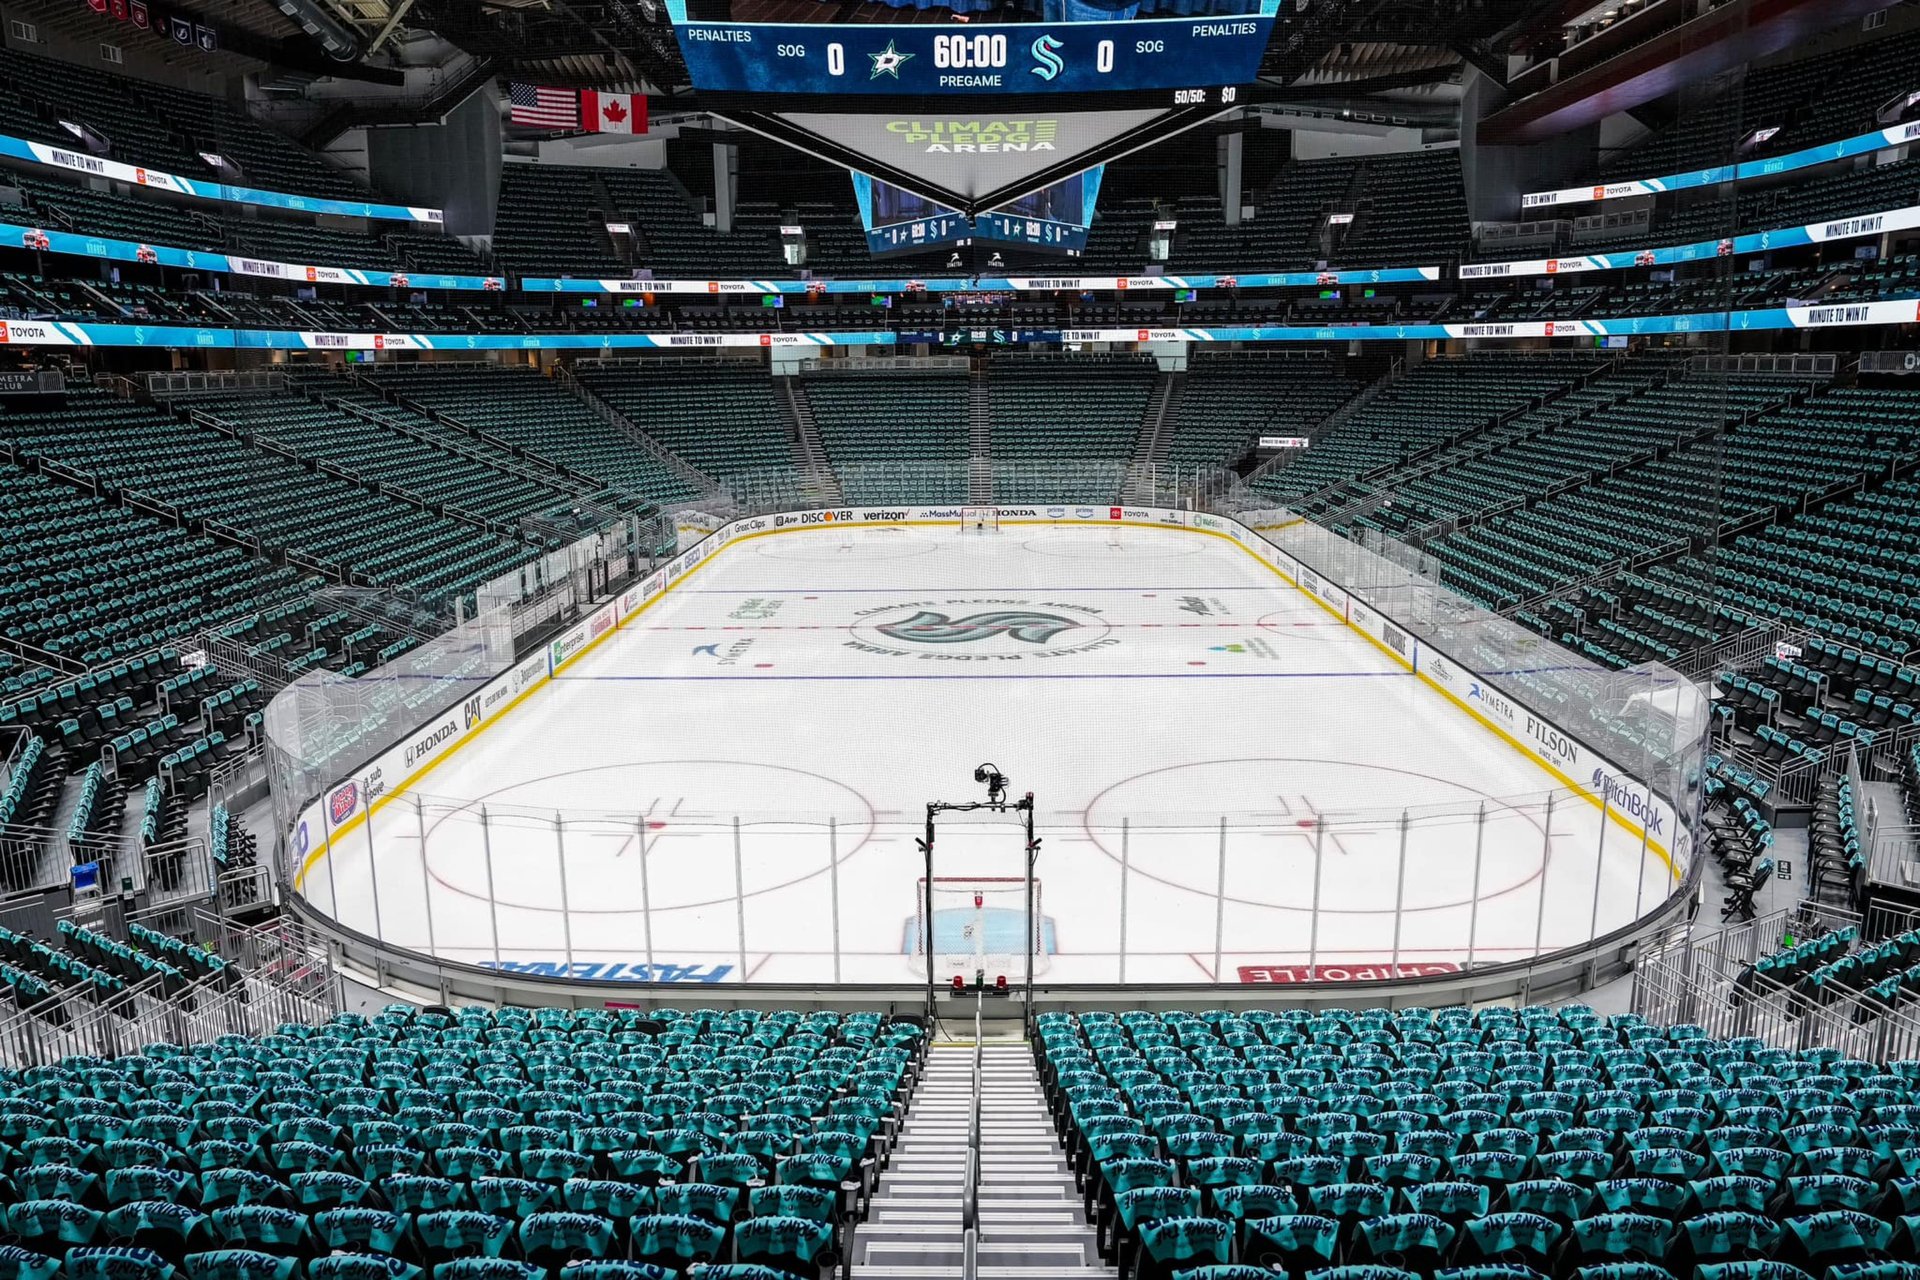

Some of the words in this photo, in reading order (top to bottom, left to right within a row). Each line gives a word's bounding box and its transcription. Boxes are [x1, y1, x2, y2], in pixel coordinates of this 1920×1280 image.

[688, 30, 752, 42] PENALTIES
[1192, 23, 1257, 37] PENALTIES
[777, 44, 806, 57] SOG
[934, 34, 1007, 69] 60:00
[1136, 40, 1165, 53] SOG
[827, 43, 845, 76] 0
[1097, 40, 1114, 73] 0
[939, 75, 1002, 87] PREGAME
[1174, 89, 1206, 104] 50/50:
[1222, 86, 1236, 103] $0
[925, 142, 1056, 153] ARENA
[52, 150, 75, 167] MINUTE
[77, 156, 84, 168] TO
[86, 158, 97, 170] WIN
[98, 161, 104, 172] IT
[148, 174, 168, 185] TOYOTA
[1606, 186, 1632, 194] TOYOTA
[1531, 196, 1538, 205] TO
[1540, 194, 1550, 204] WIN
[1552, 193, 1557, 202] IT
[1826, 223, 1850, 237] MINUTE
[1851, 220, 1859, 234] TO
[1861, 218, 1875, 232] WIN
[1876, 216, 1883, 229] IT
[1462, 266, 1483, 276] MINUTE
[1484, 266, 1491, 275] TO
[1492, 264, 1503, 274] WIN
[1504, 264, 1510, 274] IT
[620, 282, 642, 291] MINUTE
[644, 282, 652, 291] TO
[653, 282, 666, 291] WIN
[666, 282, 672, 291] IT
[1028, 280, 1051, 288] MINUTE
[1053, 280, 1060, 288] TO
[1062, 280, 1074, 288] WIN
[1074, 279, 1080, 288] IT
[1808, 308, 1834, 323] MINUTE
[1836, 308, 1844, 322] TO
[1846, 307, 1860, 322] WIN
[1861, 306, 1870, 320] IT
[10, 326, 46, 338] TOYOTA
[1072, 332, 1080, 340] TO
[1081, 332, 1093, 340] WIN
[1094, 331, 1100, 340] IT
[1463, 326, 1484, 336] MINUTE
[1486, 325, 1494, 335] TO
[1495, 325, 1507, 334] WIN
[1508, 325, 1514, 334] IT
[385, 338, 406, 346] TOYOTA
[671, 336, 694, 346] MINUTE
[695, 336, 702, 345] TO
[704, 336, 716, 345] WIN
[716, 336, 722, 345] IT
[802, 510, 853, 524] DISCOVER
[863, 509, 905, 522] verizon
[735, 522, 749, 533] Great
[750, 520, 766, 531] Clips
[1481, 688, 1514, 721] SYMETRA
[464, 695, 482, 730] CAT
[415, 720, 458, 758] HONDA
[1526, 716, 1578, 765] FILSON
[370, 766, 382, 783] sub
[366, 781, 384, 799] bove
[1603, 774, 1663, 836] PitchBook
